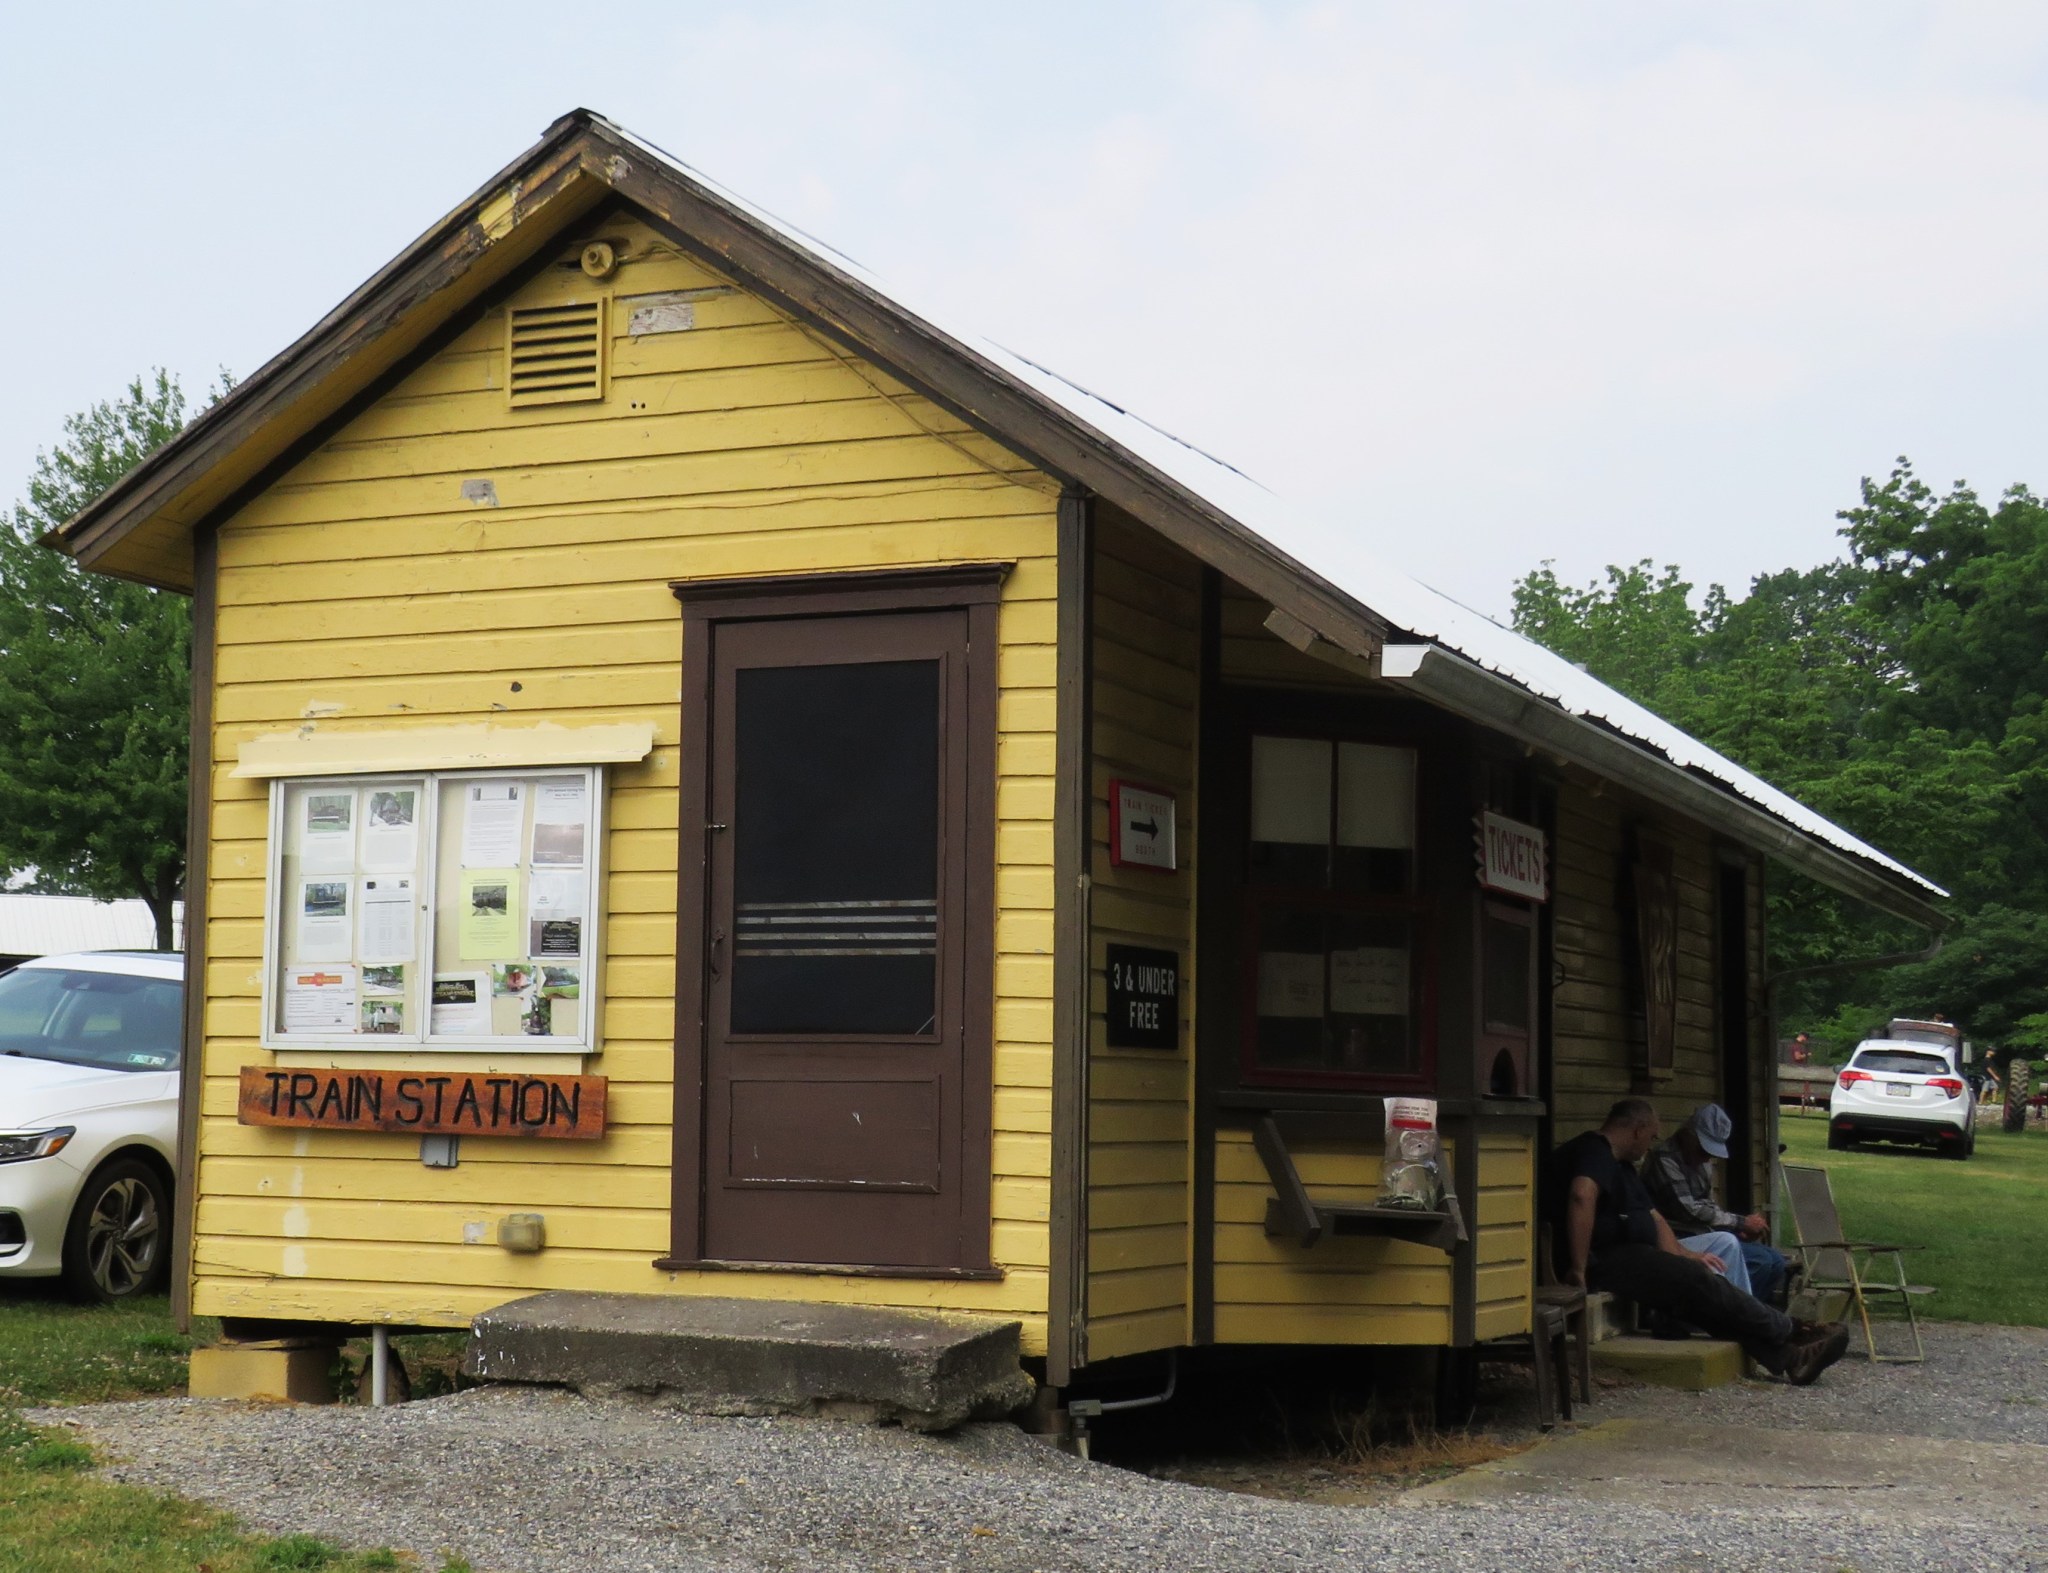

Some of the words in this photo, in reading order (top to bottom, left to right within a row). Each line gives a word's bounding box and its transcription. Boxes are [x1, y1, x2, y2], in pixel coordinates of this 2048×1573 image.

[1487, 825, 1541, 885] TICKETS
[1113, 962, 1121, 990] 3
[1125, 964, 1134, 992] &
[1138, 965, 1175, 996] UNDER
[1129, 1000, 1160, 1030] FREE
[264, 1072, 382, 1123] TRAIN
[394, 1076, 580, 1130] STATION
